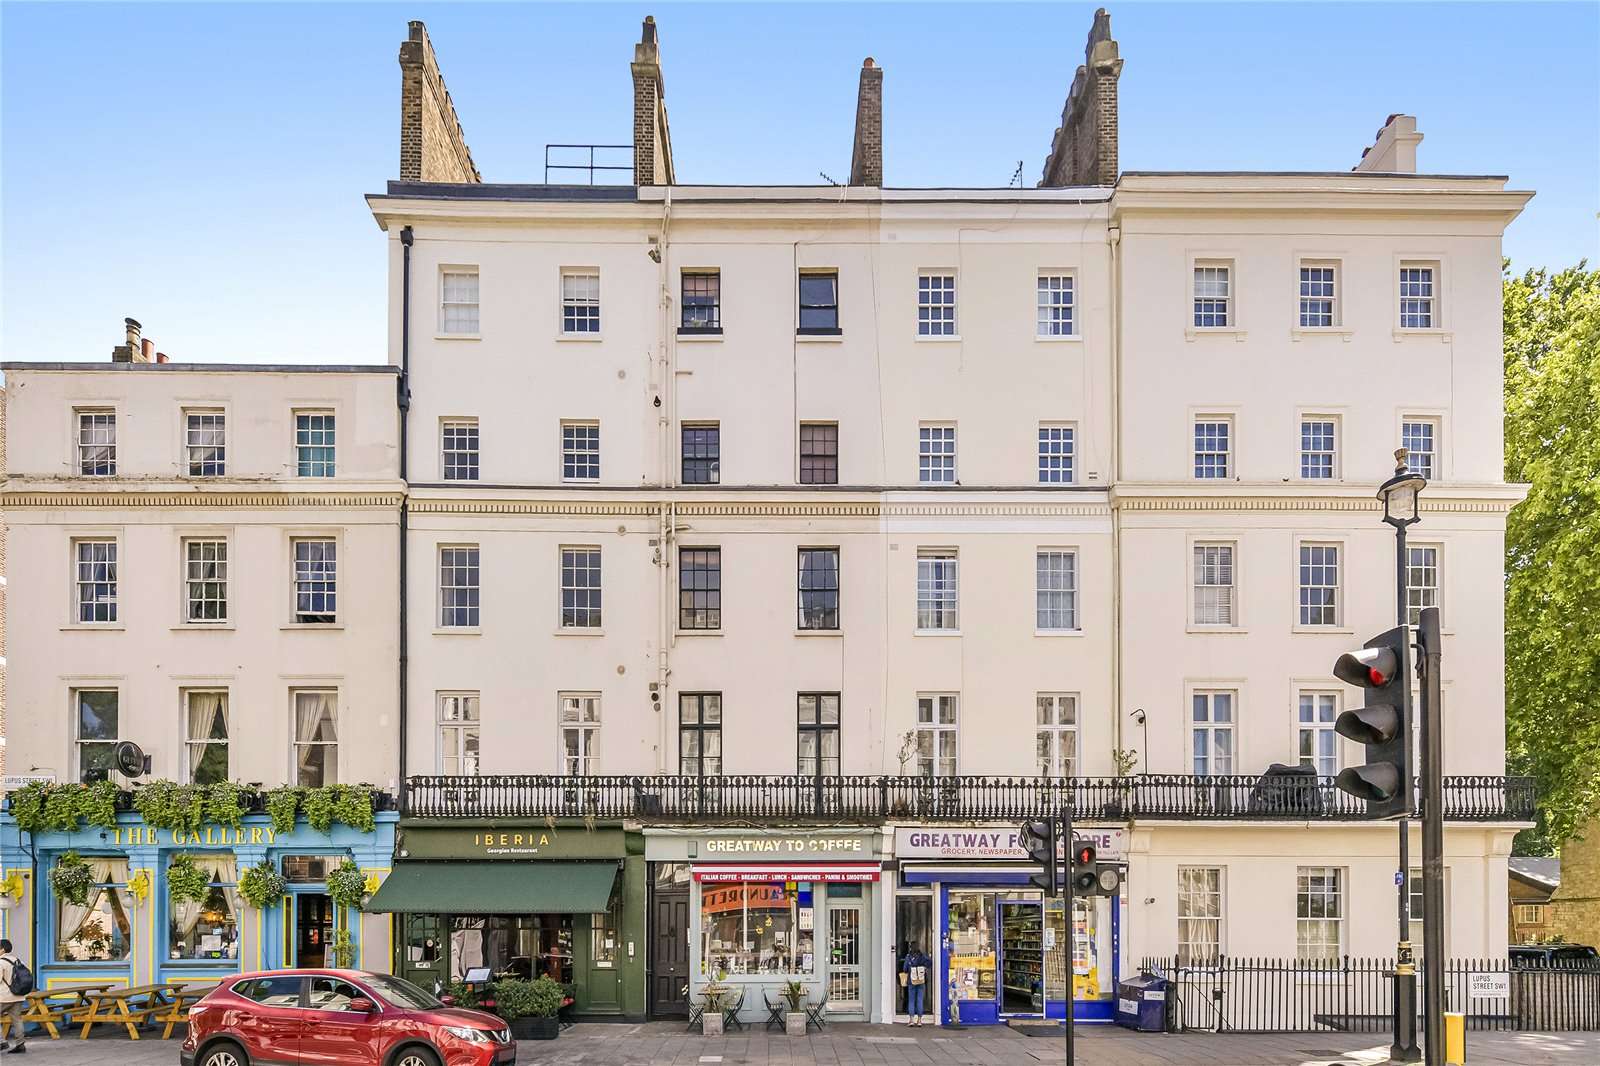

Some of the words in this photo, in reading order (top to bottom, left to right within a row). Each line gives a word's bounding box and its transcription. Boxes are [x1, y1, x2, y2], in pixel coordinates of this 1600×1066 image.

[112, 827, 160, 845] THE
[172, 826, 277, 845] GALLERY
[475, 833, 549, 846] IBERIA
[910, 833, 1001, 848] GREATWAY
[486, 847, 510, 855] Georgian
[706, 839, 783, 852] GREATWAY
[786, 839, 804, 852] TO
[808, 839, 862, 851] COFFEE
[941, 848, 977, 856] GROCERY,
[1472, 982, 1493, 990] STREET
[1494, 982, 1507, 990] SW1
